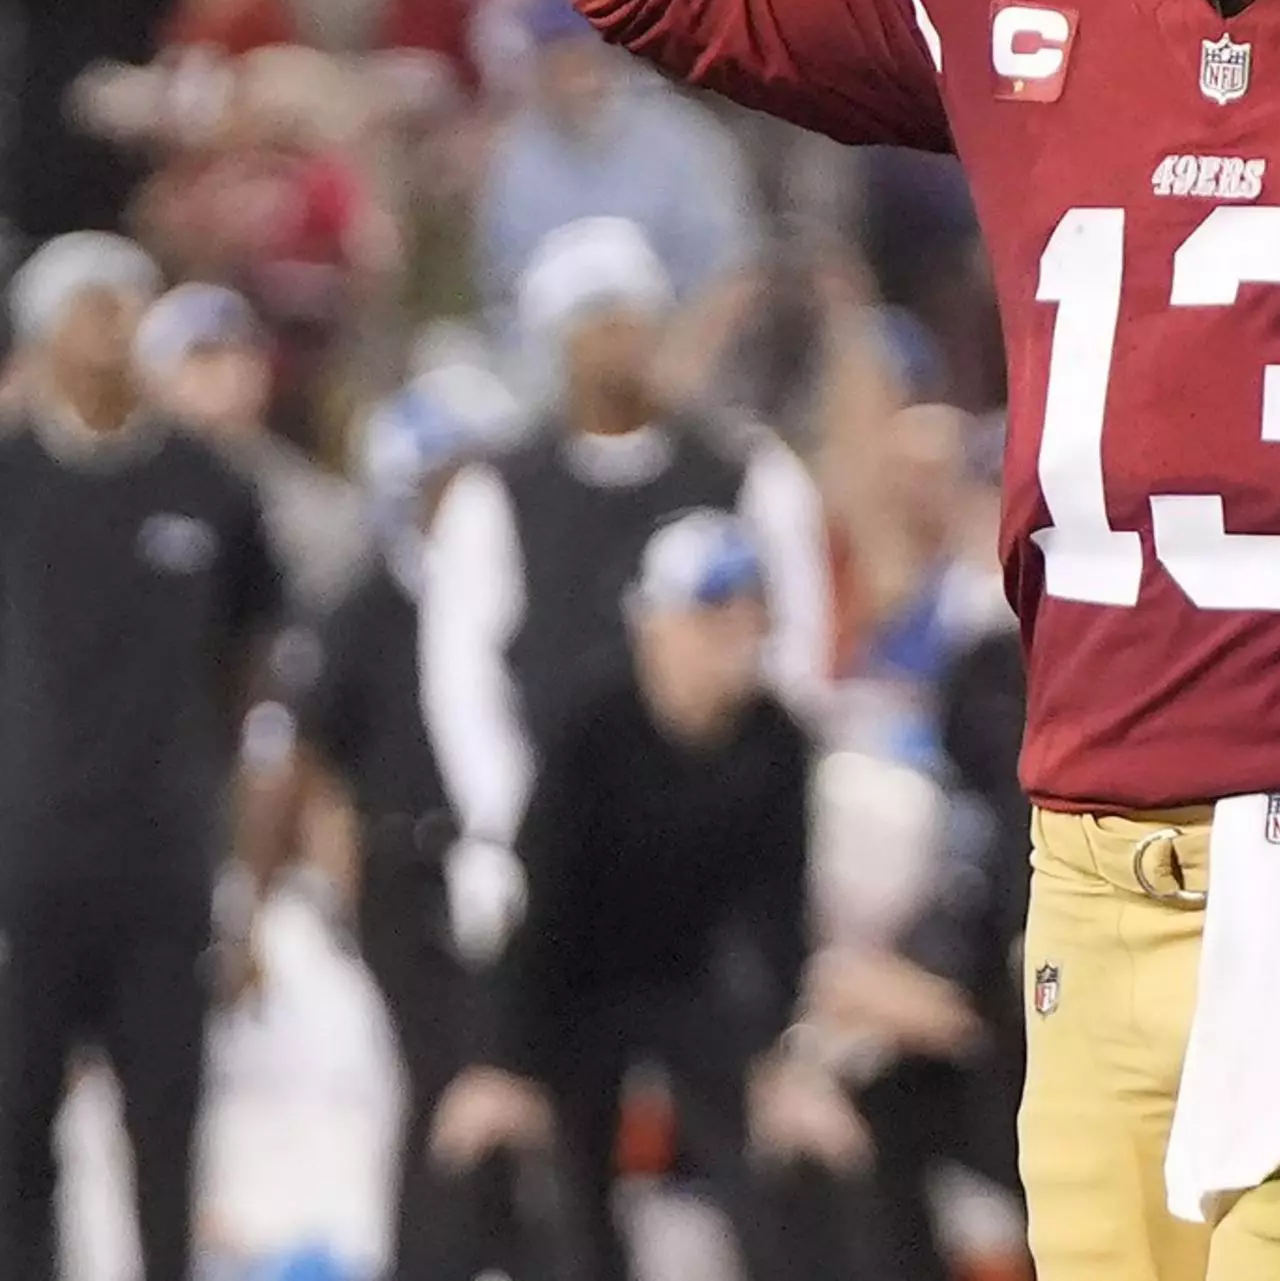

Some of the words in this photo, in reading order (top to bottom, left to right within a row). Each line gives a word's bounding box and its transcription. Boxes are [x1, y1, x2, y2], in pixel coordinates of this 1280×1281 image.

[993, 6, 1070, 78] C
[1208, 64, 1241, 90] NFL
[1151, 155, 1266, 198] 49ERS
